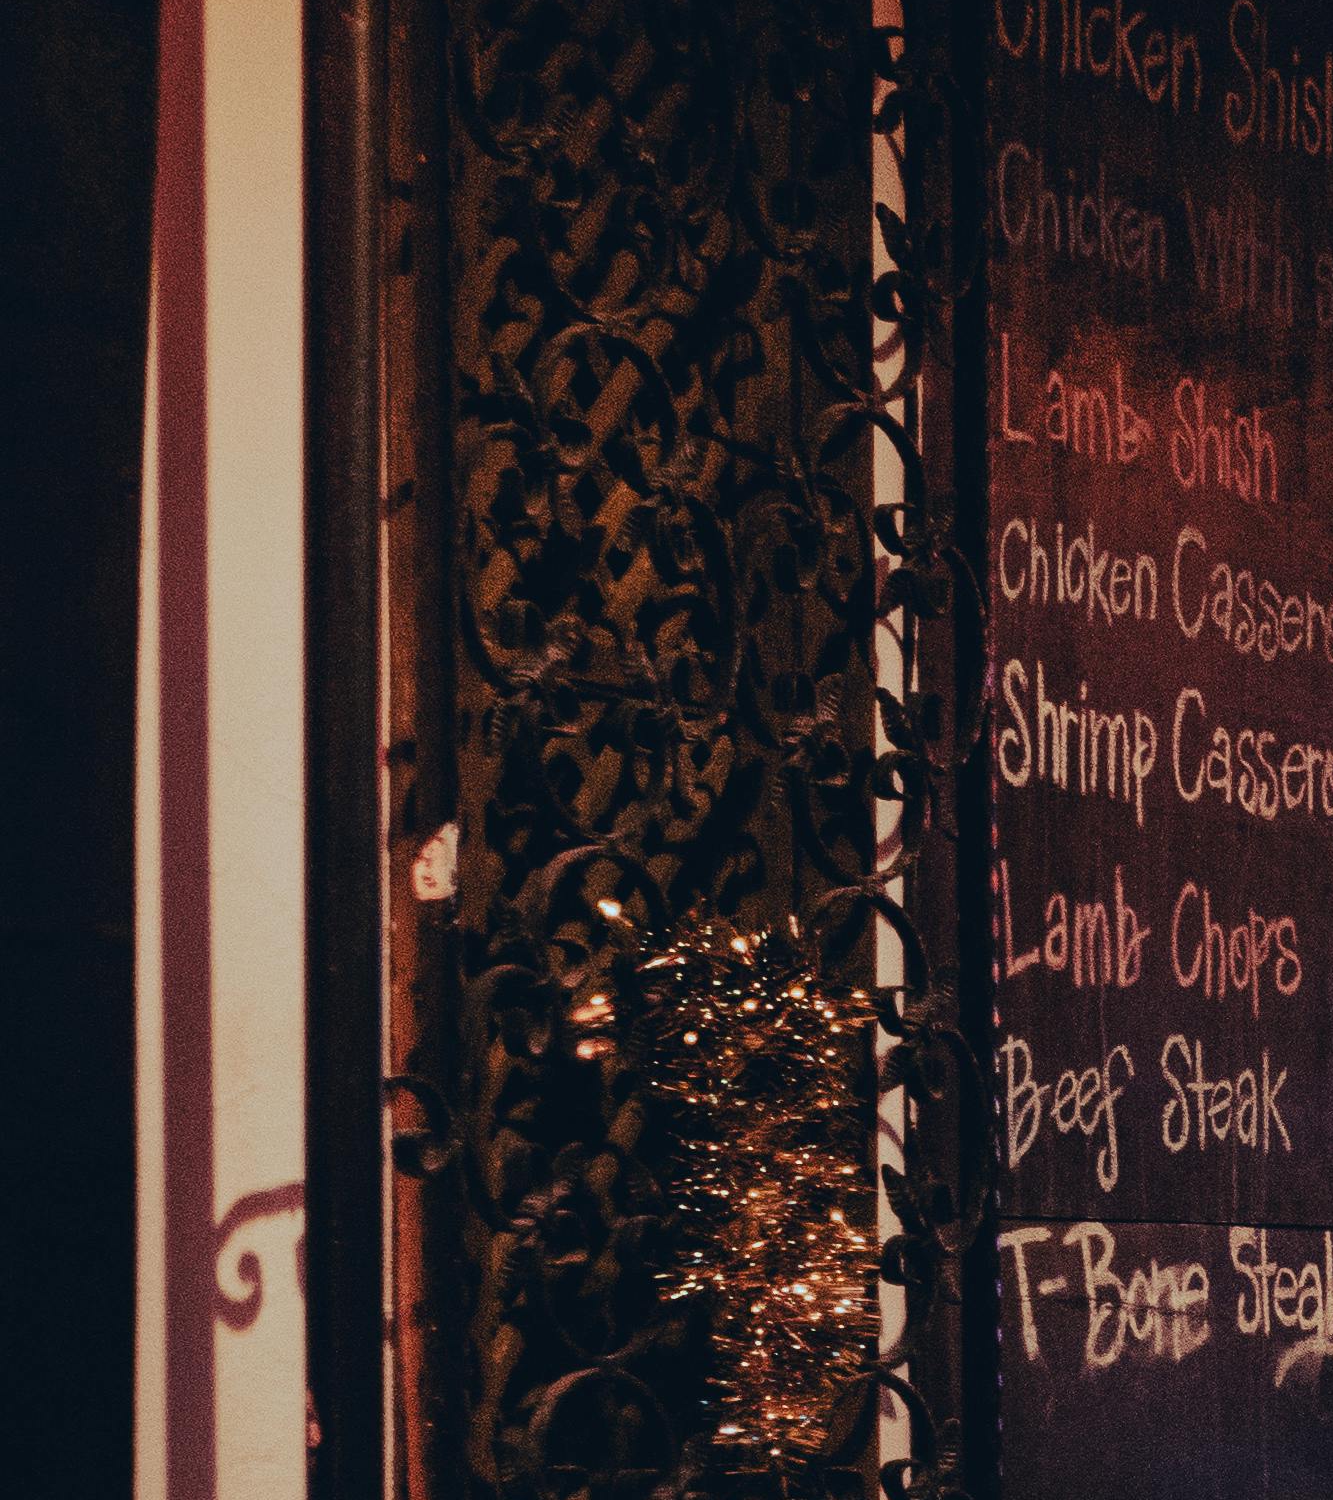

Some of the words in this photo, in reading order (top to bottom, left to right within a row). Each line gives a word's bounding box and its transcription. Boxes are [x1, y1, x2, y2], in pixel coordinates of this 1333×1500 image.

[998, 140, 1167, 281] Chicken
[1001, 332, 1154, 463] Lamb
[1171, 376, 1278, 502] Shish
[999, 517, 1159, 626] Chicken
[999, 658, 1159, 829] Shrimp
[1001, 858, 1151, 988] Lamb
[1171, 880, 1302, 1020] Chops
[1000, 1033, 1136, 1193] Beef
[1160, 1033, 1293, 1157] Steak
[999, 1221, 1211, 1369] T-Bone
